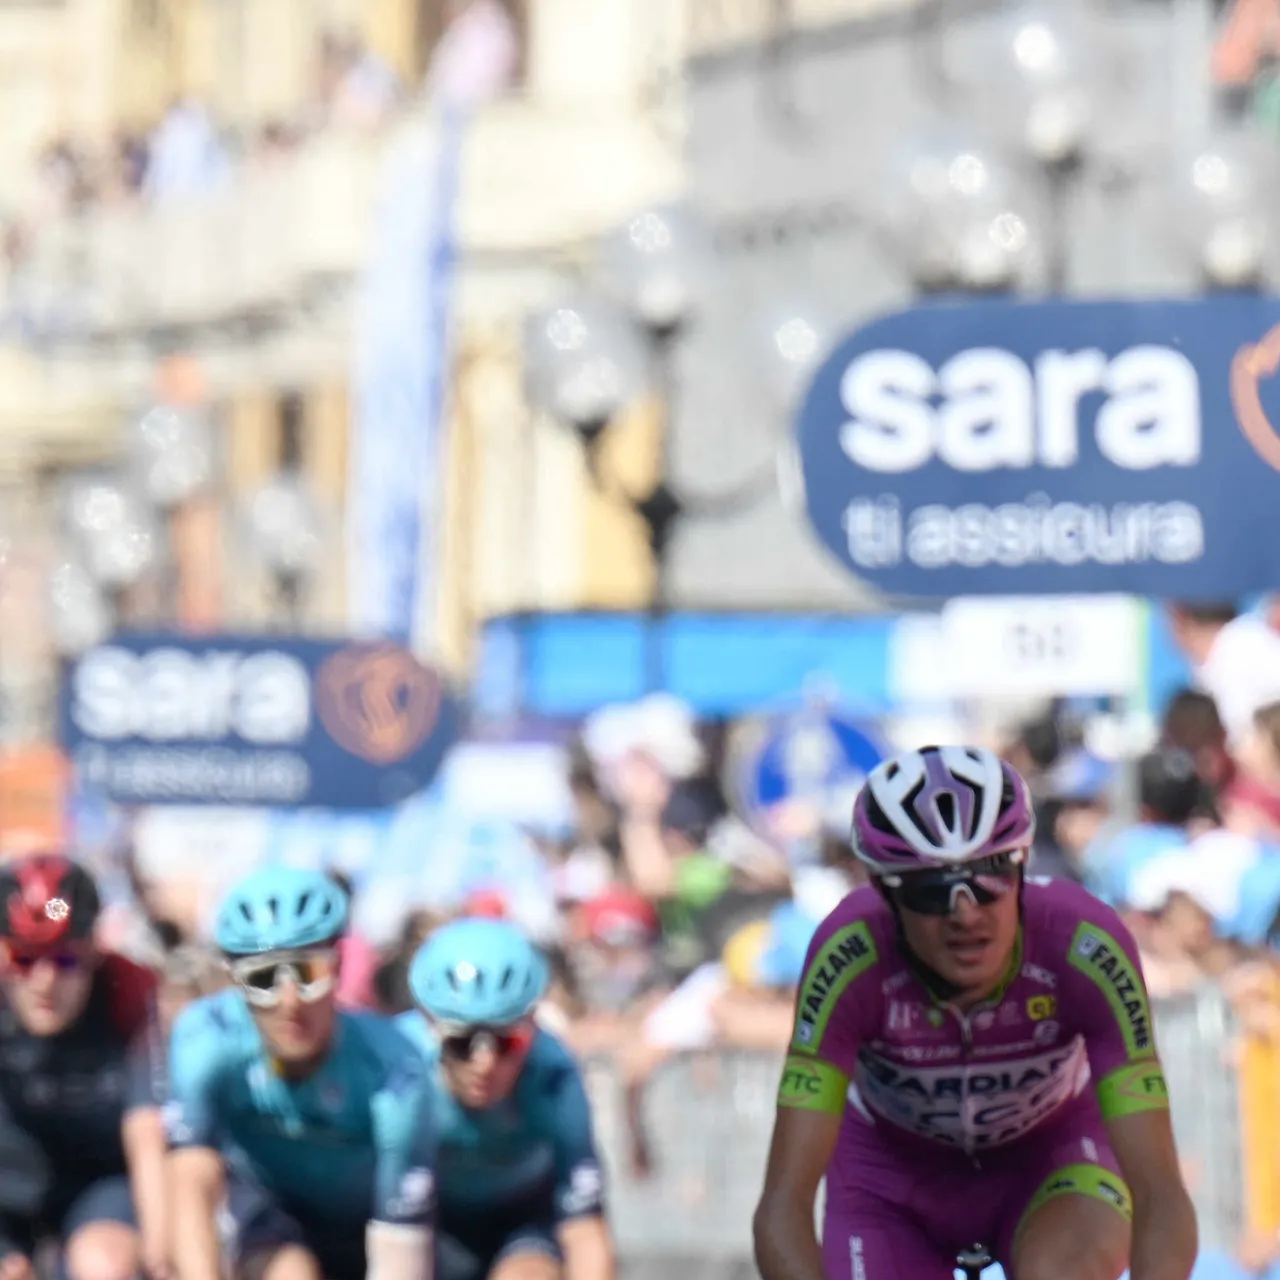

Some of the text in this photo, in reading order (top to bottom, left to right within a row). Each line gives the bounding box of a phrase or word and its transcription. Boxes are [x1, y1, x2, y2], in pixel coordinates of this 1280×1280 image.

[839, 345, 1200, 471] sara
[844, 492, 1202, 567] ti assicura
[72, 647, 308, 742] sara
[1090, 944, 1149, 1048] FAIZANE
